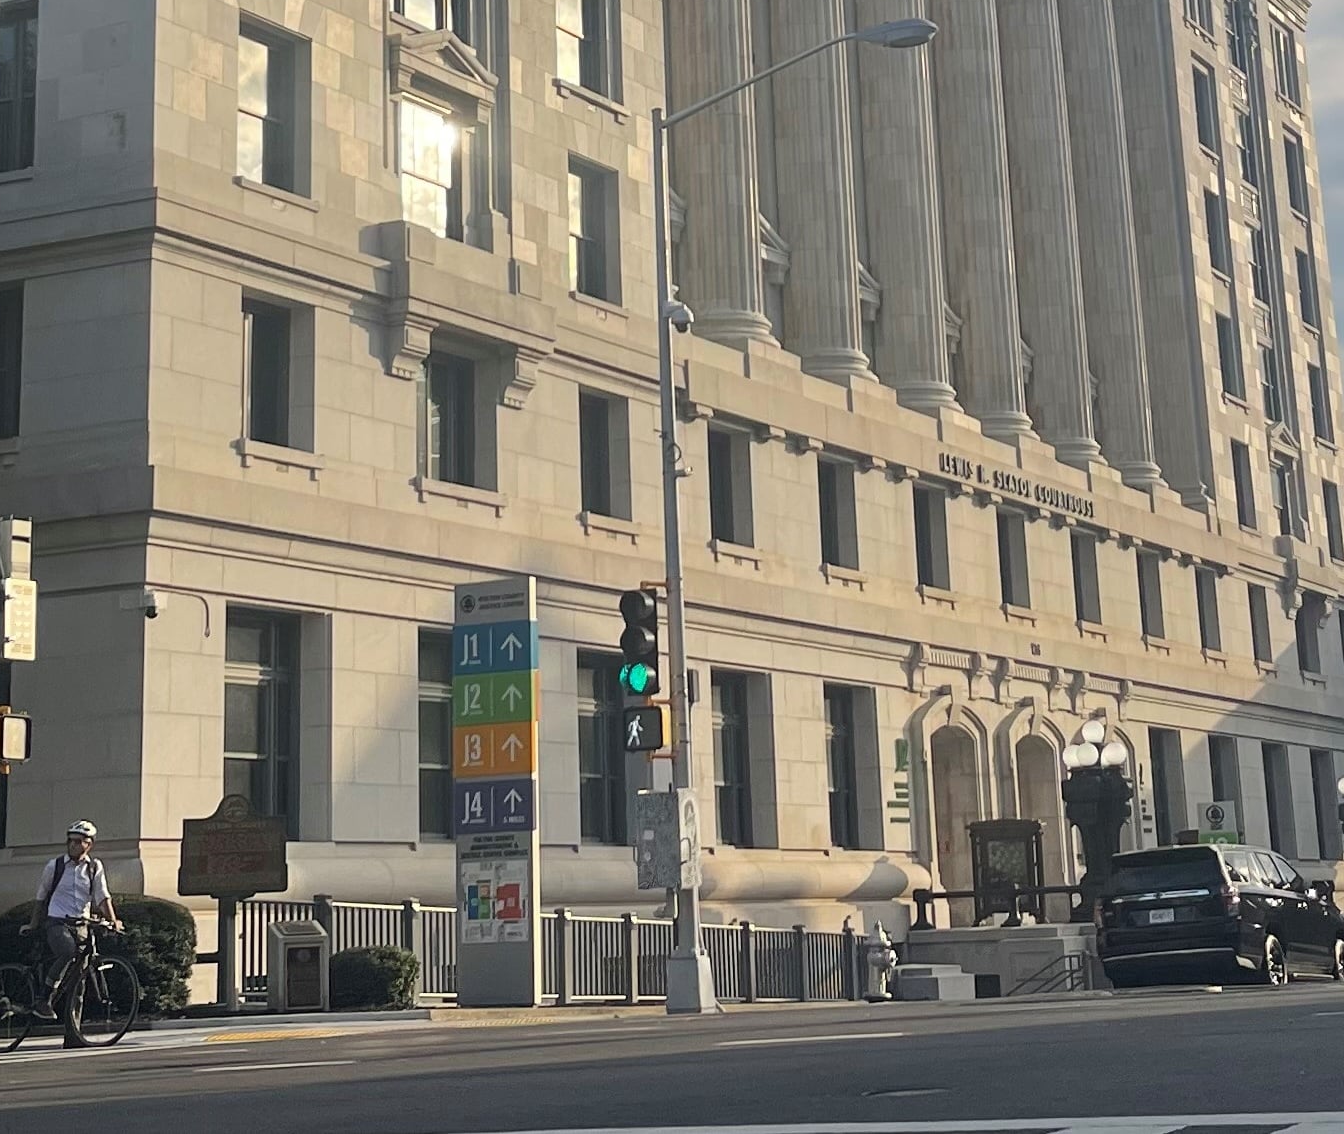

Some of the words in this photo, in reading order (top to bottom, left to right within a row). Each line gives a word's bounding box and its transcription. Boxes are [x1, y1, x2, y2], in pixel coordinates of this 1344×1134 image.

[460, 633, 479, 666] J1
[461, 683, 481, 716] J2
[462, 734, 482, 767] J3
[462, 791, 484, 824] J4
